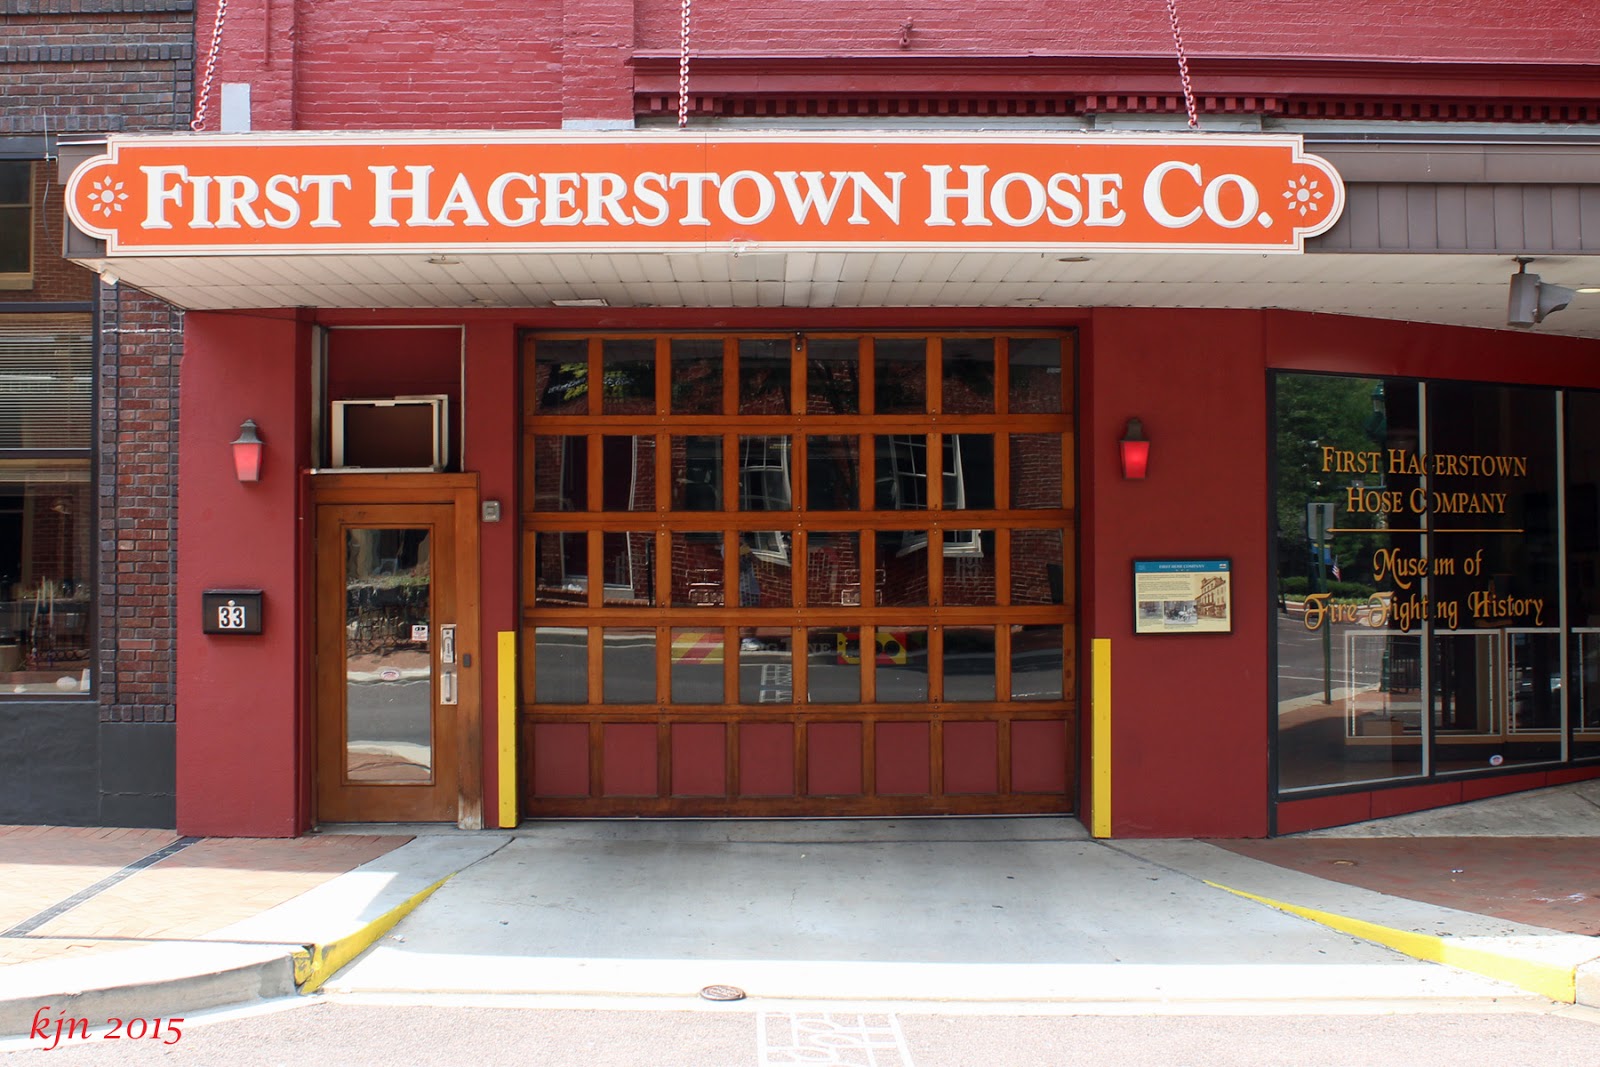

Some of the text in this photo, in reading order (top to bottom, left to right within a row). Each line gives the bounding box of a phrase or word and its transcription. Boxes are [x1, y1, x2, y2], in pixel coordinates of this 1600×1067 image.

[139, 160, 1274, 230] FIRST HAGERSTOWN HOSE CO.
[1321, 446, 1382, 474] FIRST
[1346, 486, 1404, 514] HOSE
[1463, 548, 1484, 577] of
[220, 607, 243, 628] 33
[1303, 590, 1545, 632] Fire Fightng History
